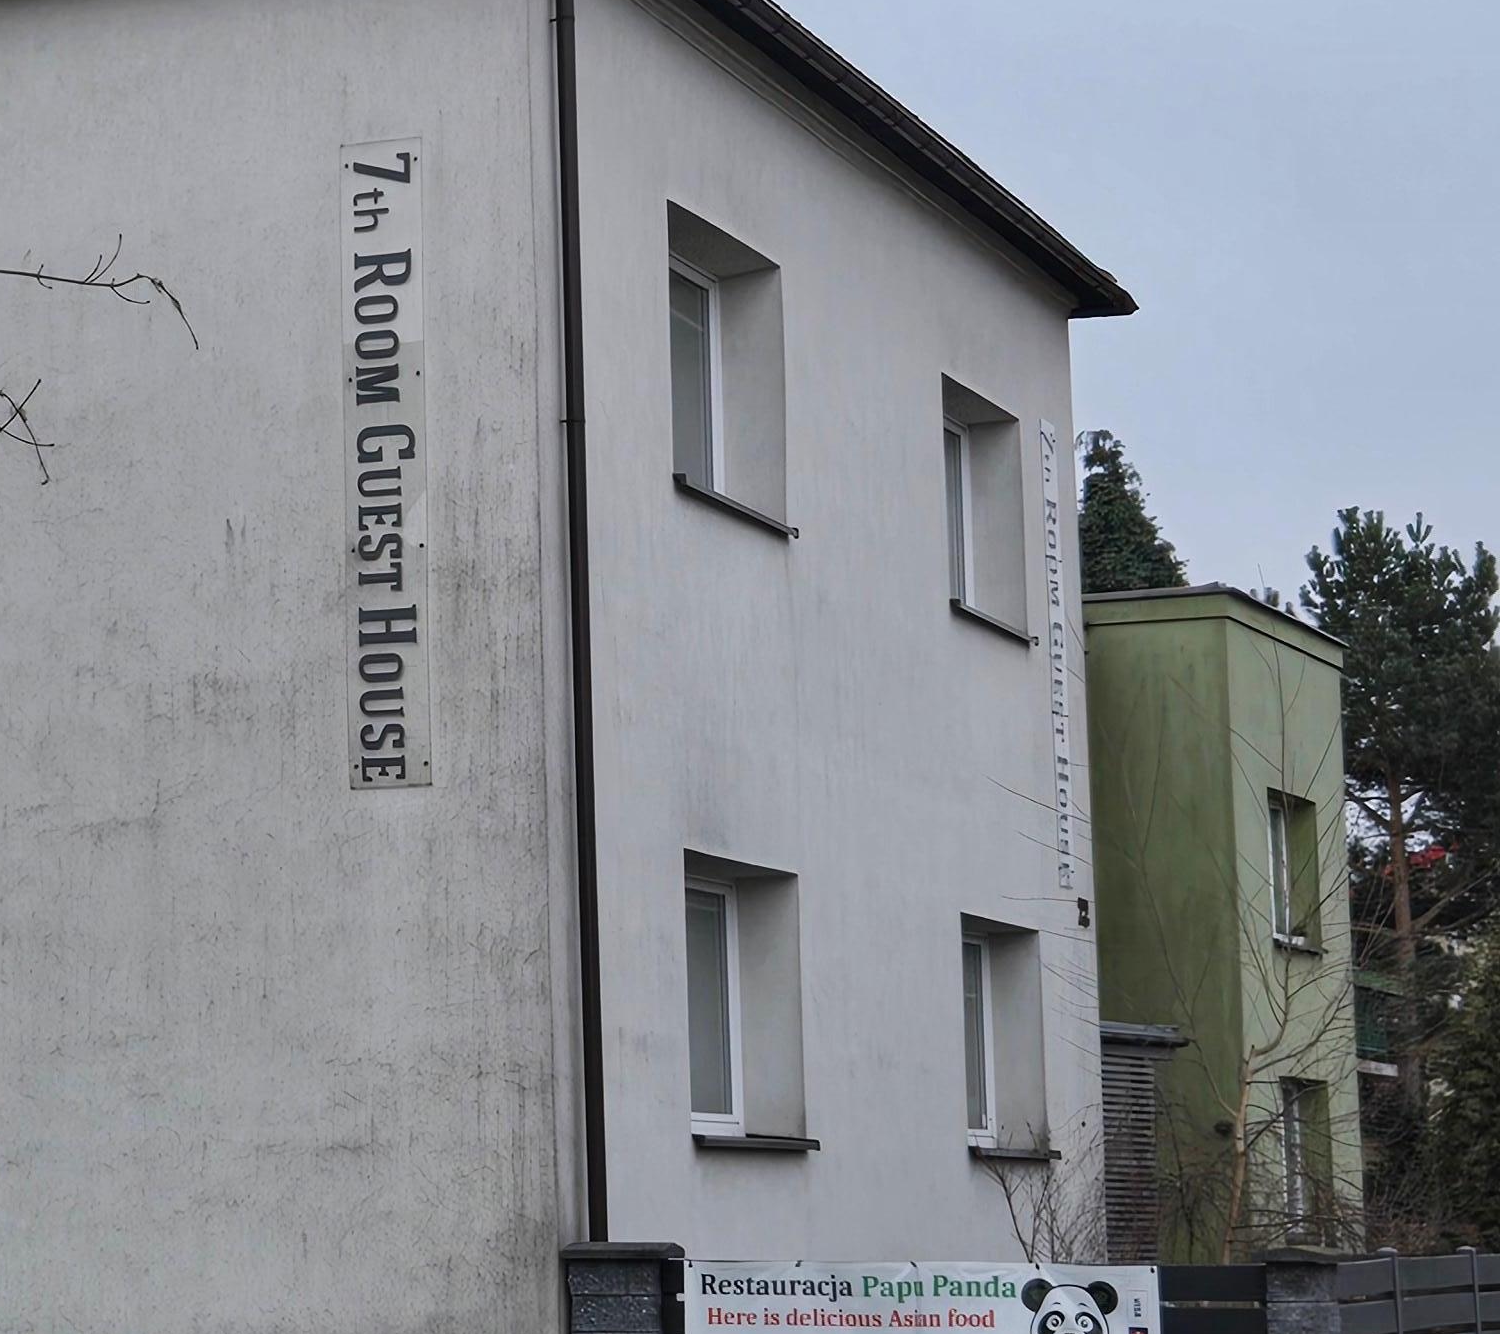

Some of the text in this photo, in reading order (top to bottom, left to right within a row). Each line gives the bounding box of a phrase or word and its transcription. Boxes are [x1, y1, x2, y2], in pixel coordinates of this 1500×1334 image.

[352, 152, 417, 782] 7th ROOM GUEST HOUSE
[701, 1273, 1017, 1303] Restauracja Papu Panda
[707, 1307, 996, 1328] Here is delicious Asian food
